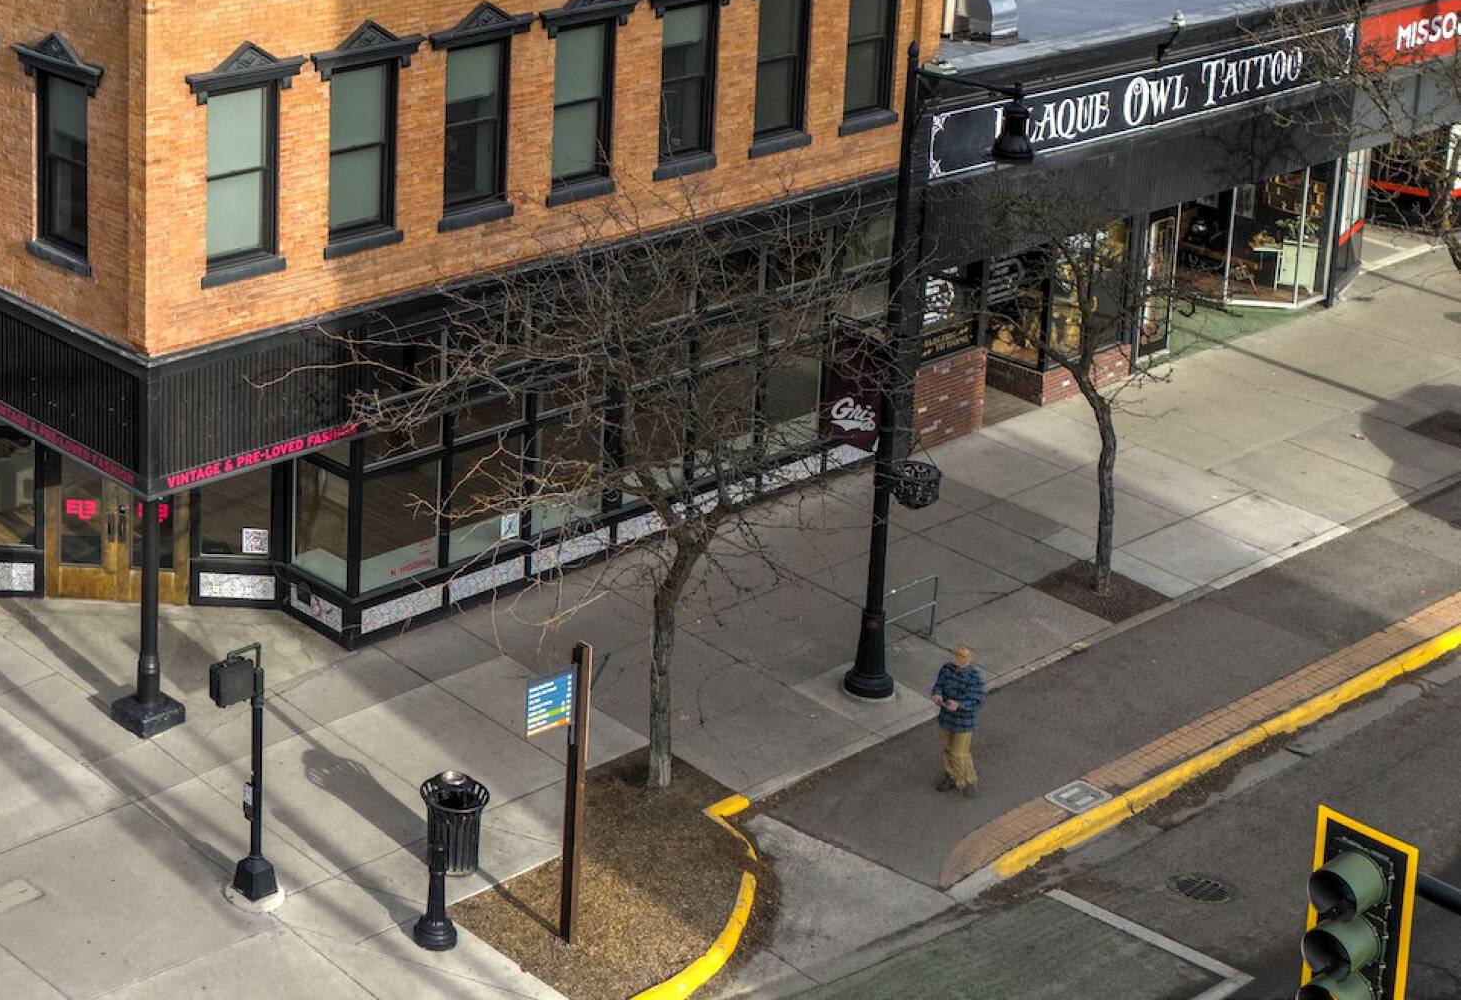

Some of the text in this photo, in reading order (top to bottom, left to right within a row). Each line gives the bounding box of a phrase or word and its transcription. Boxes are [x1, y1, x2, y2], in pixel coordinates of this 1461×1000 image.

[1396, 12, 1461, 51] MISSO
[29, 421, 37, 432] &
[39, 425, 89, 461] PRE-LOVED
[91, 452, 136, 485] FASHION
[167, 462, 221, 488] VINTAGE
[224, 457, 233, 472] &
[236, 439, 304, 468] PRE-LOVED
